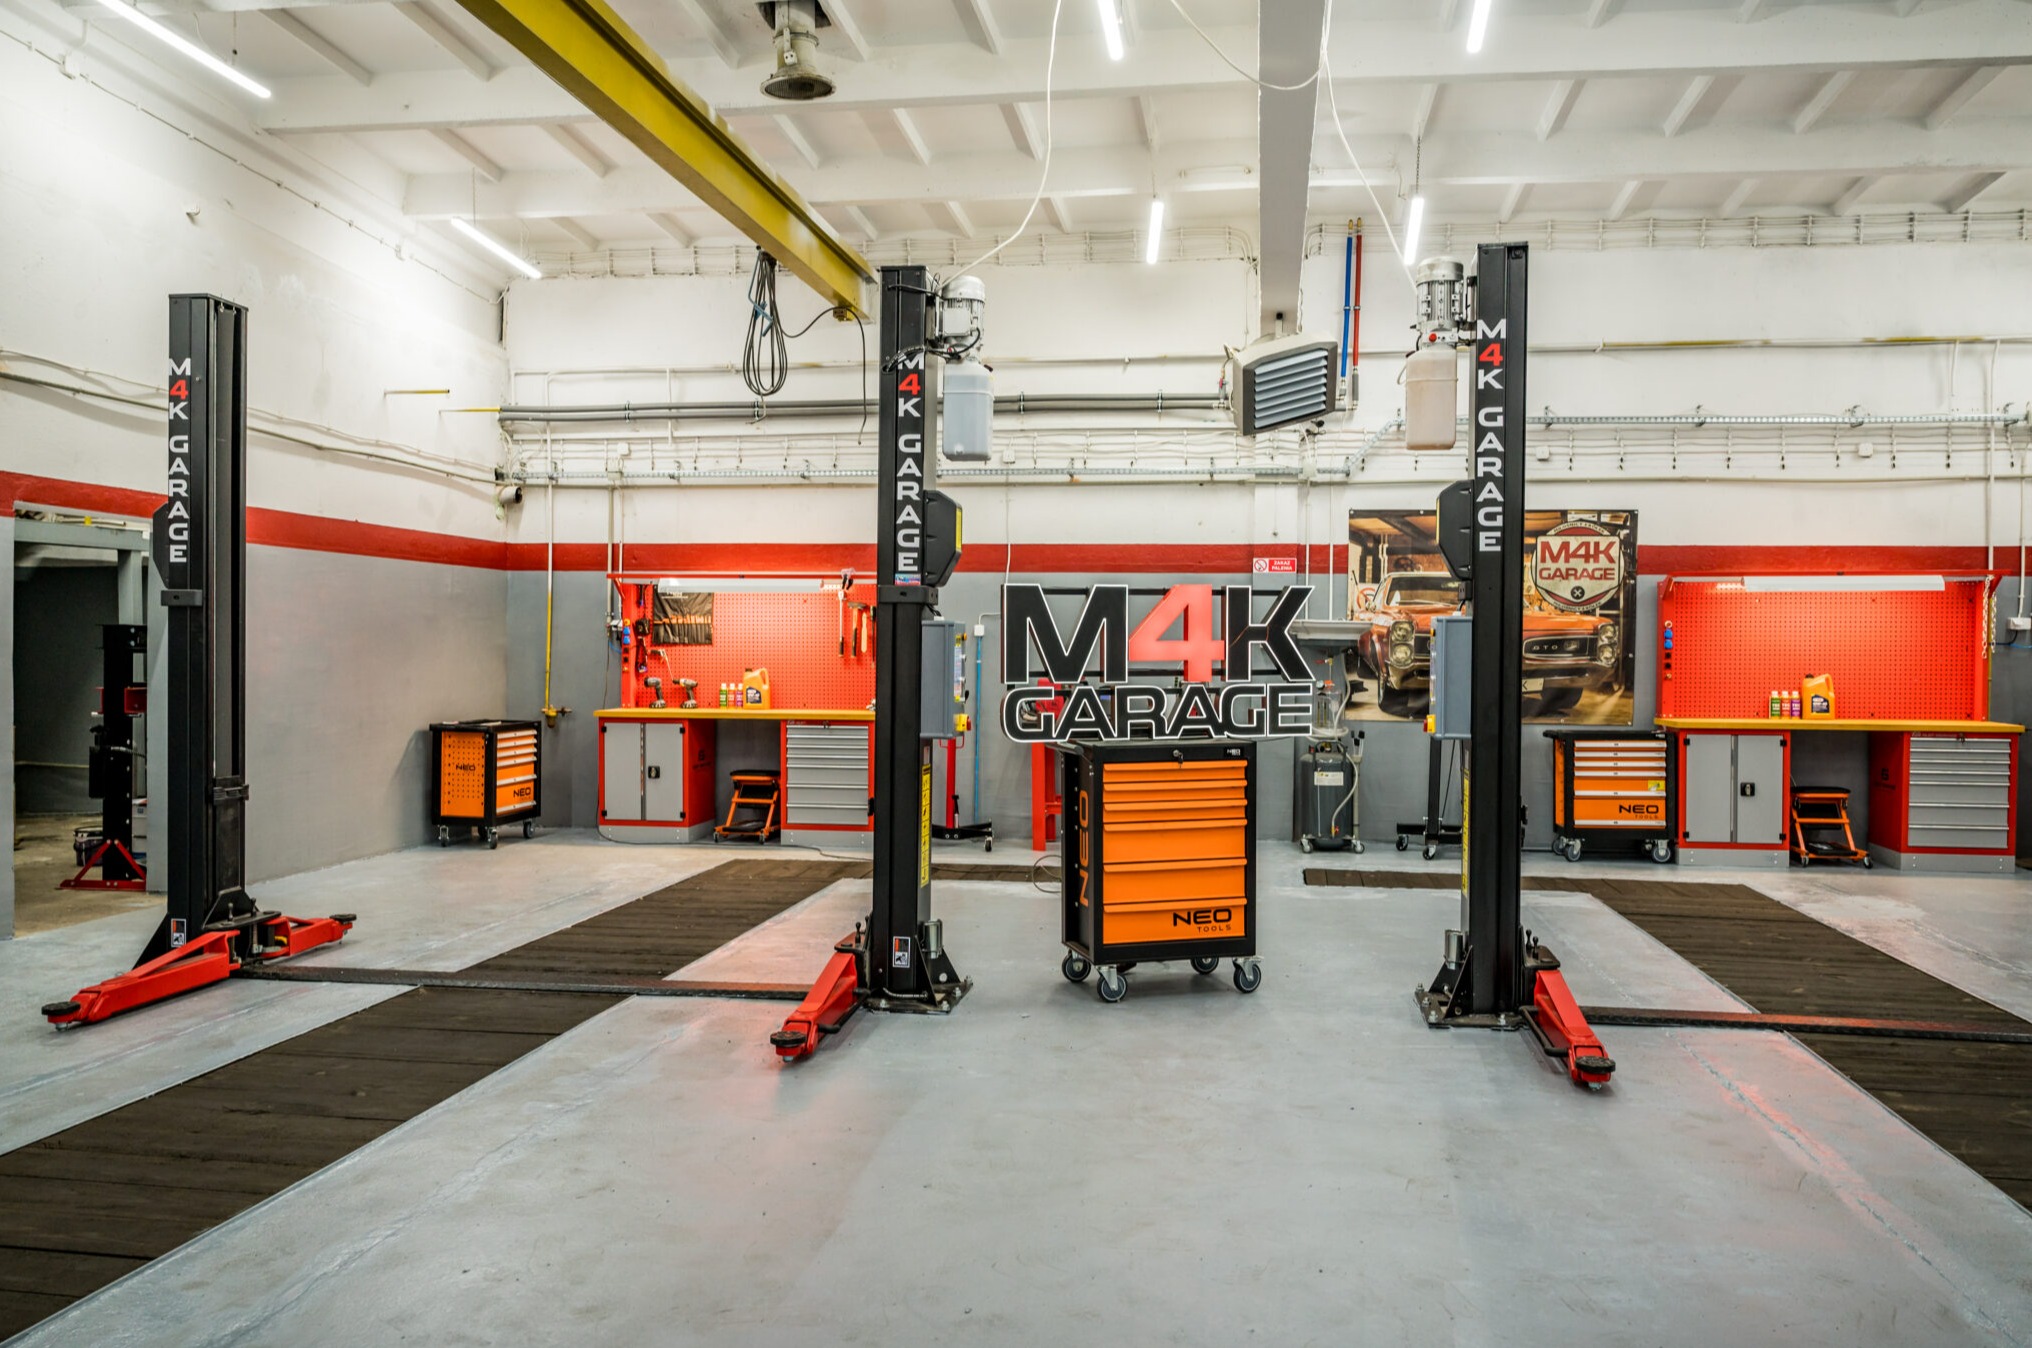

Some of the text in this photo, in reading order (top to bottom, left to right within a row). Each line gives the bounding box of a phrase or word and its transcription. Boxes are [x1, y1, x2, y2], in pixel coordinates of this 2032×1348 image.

[897, 352, 925, 418] M4K
[1476, 318, 1507, 552] M4K GARAGE
[168, 358, 191, 563] M4K GARAGE
[896, 434, 923, 572] GARAGE
[1540, 541, 1616, 564] M4K
[1538, 567, 1616, 581] GARAGE
[1002, 583, 1316, 684] M4K
[1002, 683, 1313, 743] GARAGE
[455, 763, 476, 771] NEO
[513, 787, 531, 797] NEO
[1618, 804, 1660, 814] NEO
[1079, 790, 1089, 907] NEO
[1173, 908, 1233, 927] NEO
[1197, 924, 1232, 933] TOOLS
